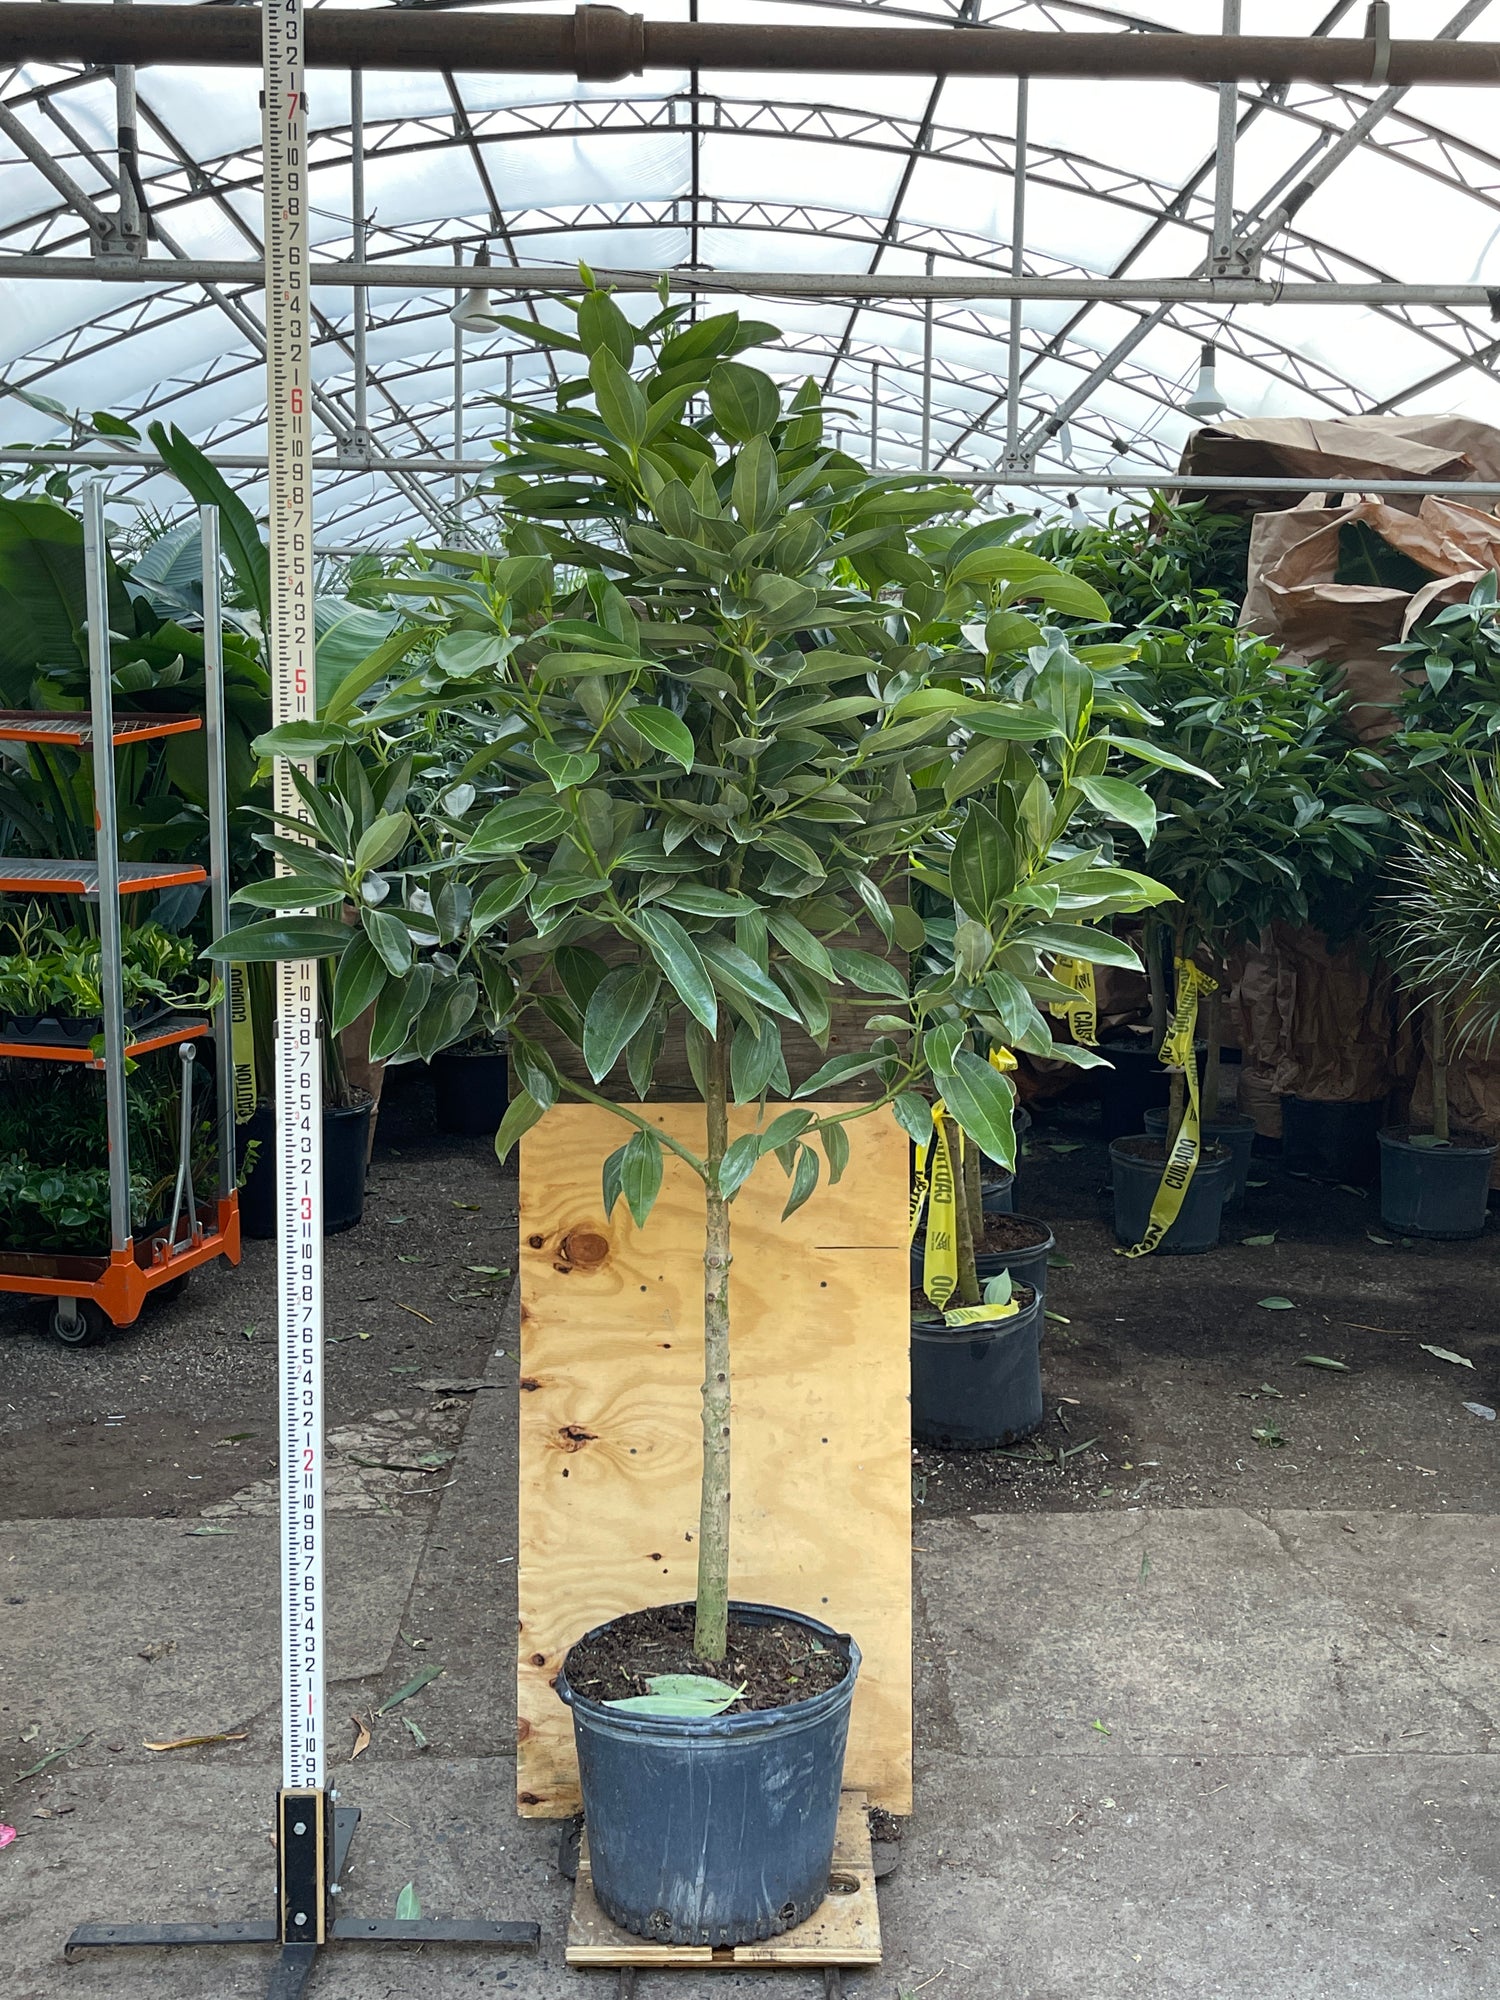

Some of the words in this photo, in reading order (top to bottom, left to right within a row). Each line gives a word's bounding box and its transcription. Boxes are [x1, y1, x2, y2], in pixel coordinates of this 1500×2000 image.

[286, 20, 298, 40] 3
[286, 46, 298, 66] 2
[287, 93, 298, 120] 7
[288, 122, 297, 141] 11
[287, 147, 299, 167] 10
[287, 172, 299, 191] 9
[288, 197, 300, 216] 8
[288, 222, 300, 240] 7
[289, 246, 301, 265] 6
[289, 271, 301, 290] 5
[290, 295, 301, 314] 4
[290, 319, 302, 338] 3
[290, 344, 302, 362] 2
[291, 388, 303, 414] 6
[293, 416, 302, 434] 11
[292, 439, 303, 457] 10
[292, 463, 304, 481] 9
[292, 486, 304, 504] 8
[293, 510, 304, 528] 7
[293, 534, 304, 551] 6
[293, 557, 305, 575] 5
[294, 580, 305, 598] 4
[294, 603, 305, 621] 3
[294, 627, 306, 644] 2
[295, 669, 306, 694] 5
[297, 696, 306, 713] 11
[300, 963, 309, 980] 11
[300, 985, 311, 1002] 10
[300, 1007, 311, 1024] 9
[299, 1029, 310, 1046] 8
[300, 1051, 310, 1067] 7
[300, 1072, 311, 1089] 6
[235, 1063, 255, 1118] CAUTION
[300, 1094, 311, 1110] 5
[301, 1116, 311, 1132] 4
[301, 1137, 311, 1153] 3
[301, 1158, 311, 1174] 2
[1164, 1138, 1197, 1190] CUIDADO
[301, 1197, 312, 1220] 3
[303, 1222, 311, 1238] 11
[302, 1243, 312, 1259] 10
[302, 1264, 312, 1280] 9
[302, 1285, 313, 1301] 8
[302, 1306, 313, 1323] 7
[302, 1327, 313, 1343] 6
[302, 1348, 313, 1364] 5
[303, 1369, 313, 1385] 4
[303, 1390, 313, 1406] 3
[303, 1411, 313, 1427] 2
[303, 1449, 314, 1471] 2
[304, 1473, 313, 1489] 11
[304, 1494, 314, 1509] 10
[304, 1514, 314, 1530] 9
[304, 1535, 314, 1550] 8
[304, 1555, 314, 1571] 7
[304, 1576, 315, 1591] 6
[304, 1596, 315, 1612] 5
[305, 1616, 315, 1632] 4
[305, 1636, 315, 1652] 3
[305, 1657, 315, 1672] 2
[306, 1717, 315, 1733] 11
[306, 1738, 316, 1753] 10
[306, 1757, 316, 1773] 9
